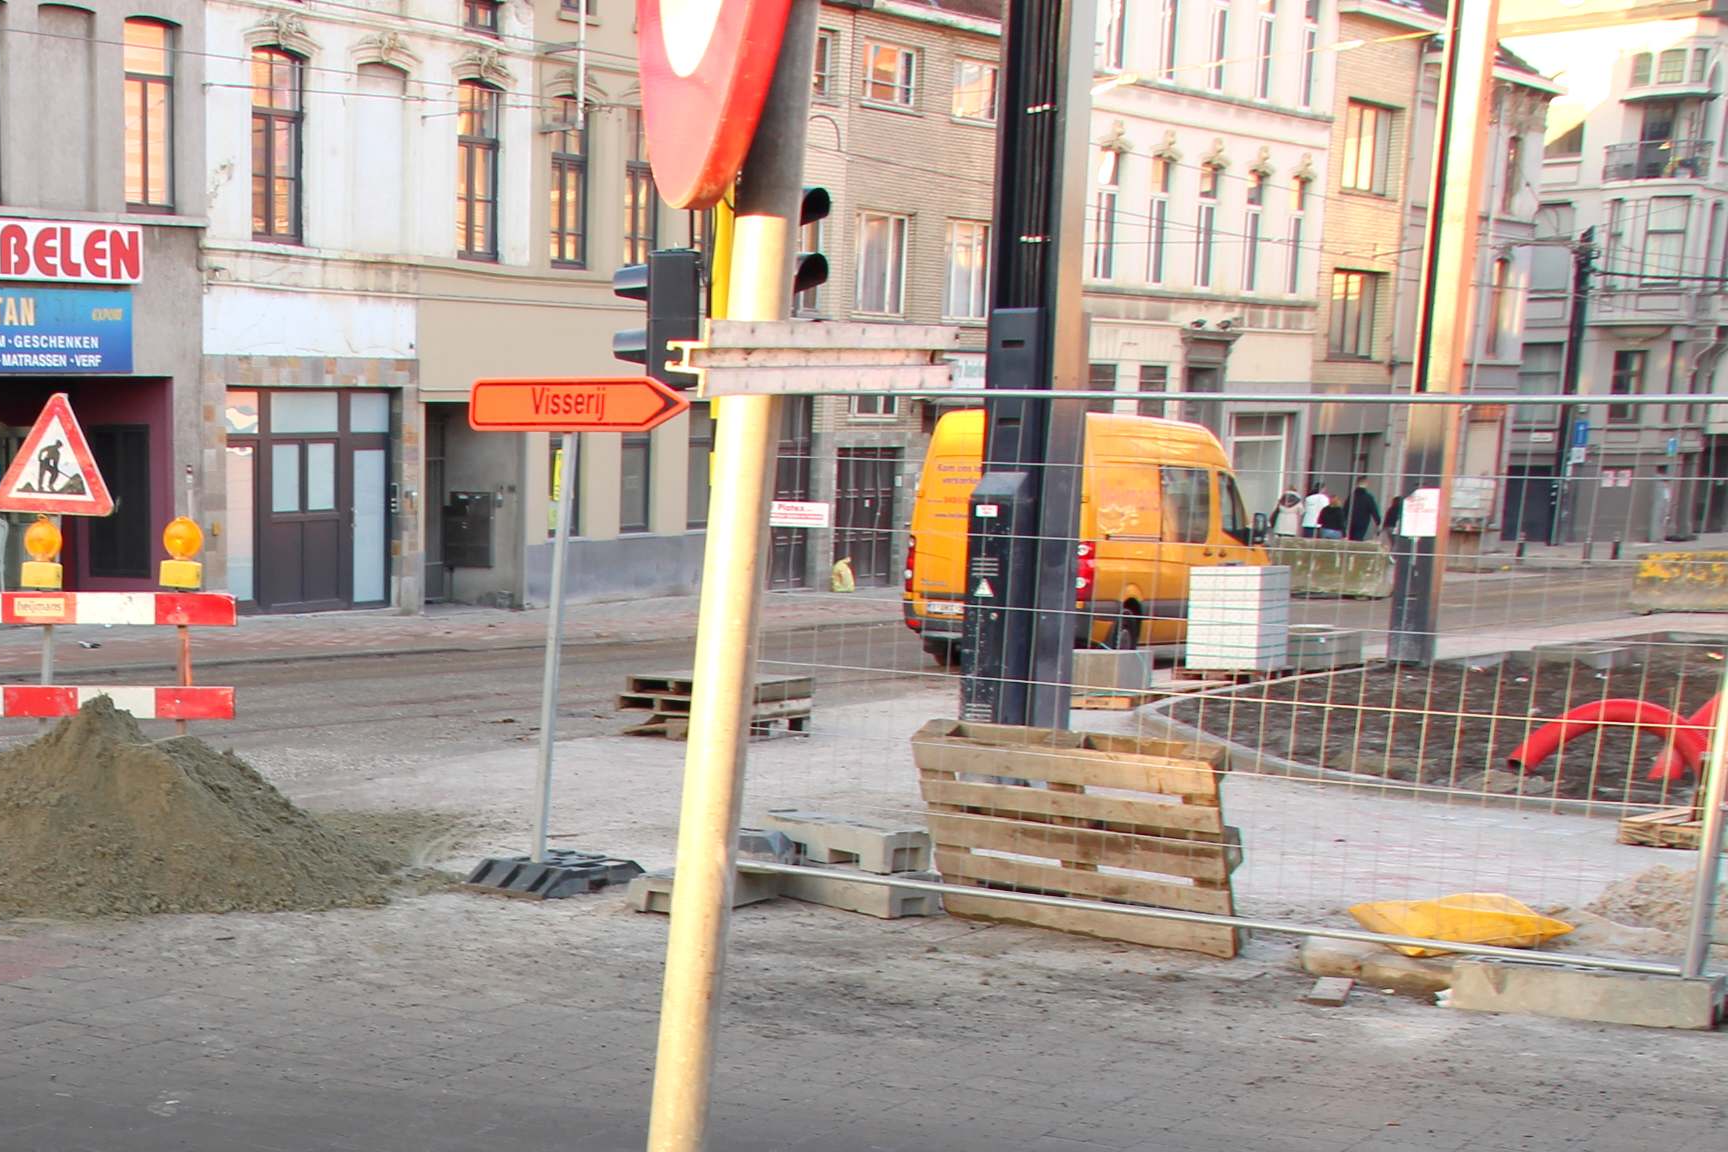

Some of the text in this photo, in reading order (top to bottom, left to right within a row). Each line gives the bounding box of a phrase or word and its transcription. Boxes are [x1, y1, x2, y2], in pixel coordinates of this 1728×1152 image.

[14, 336, 100, 349] GESCHENKEN
[1, 354, 68, 367] MATRASSEN
[74, 354, 103, 367] VERF
[531, 387, 606, 421] Visserij
[16, 599, 61, 613] heijmans
